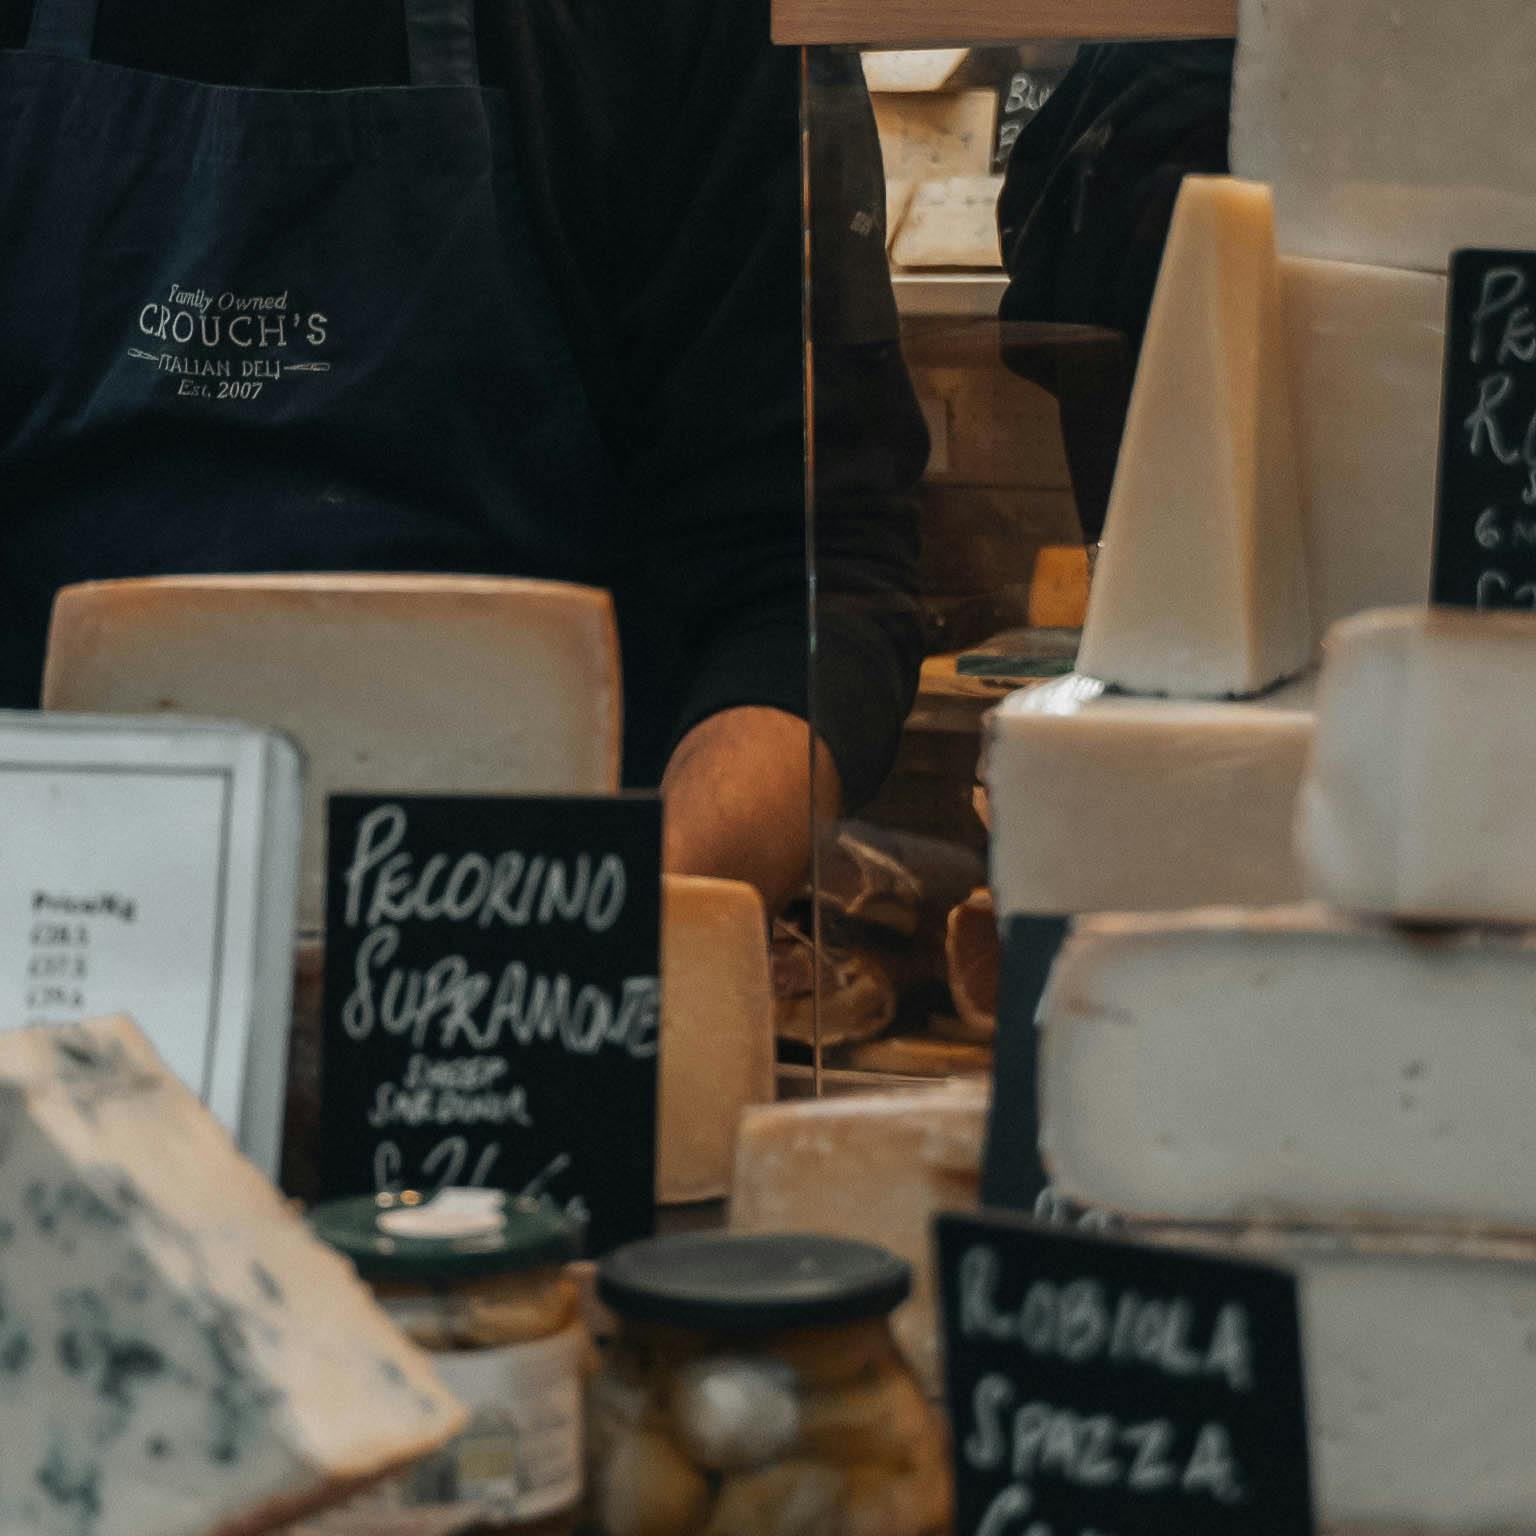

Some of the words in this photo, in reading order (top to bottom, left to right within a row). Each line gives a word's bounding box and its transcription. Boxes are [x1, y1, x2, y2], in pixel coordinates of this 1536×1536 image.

[167, 284, 213, 314] Family
[218, 290, 288, 311] Owned
[139, 304, 328, 347] CROUCH'S
[158, 354, 231, 377] ITALIAN
[241, 360, 280, 380] DELI
[217, 381, 263, 400] 2007
[344, 804, 628, 932] PECORINO
